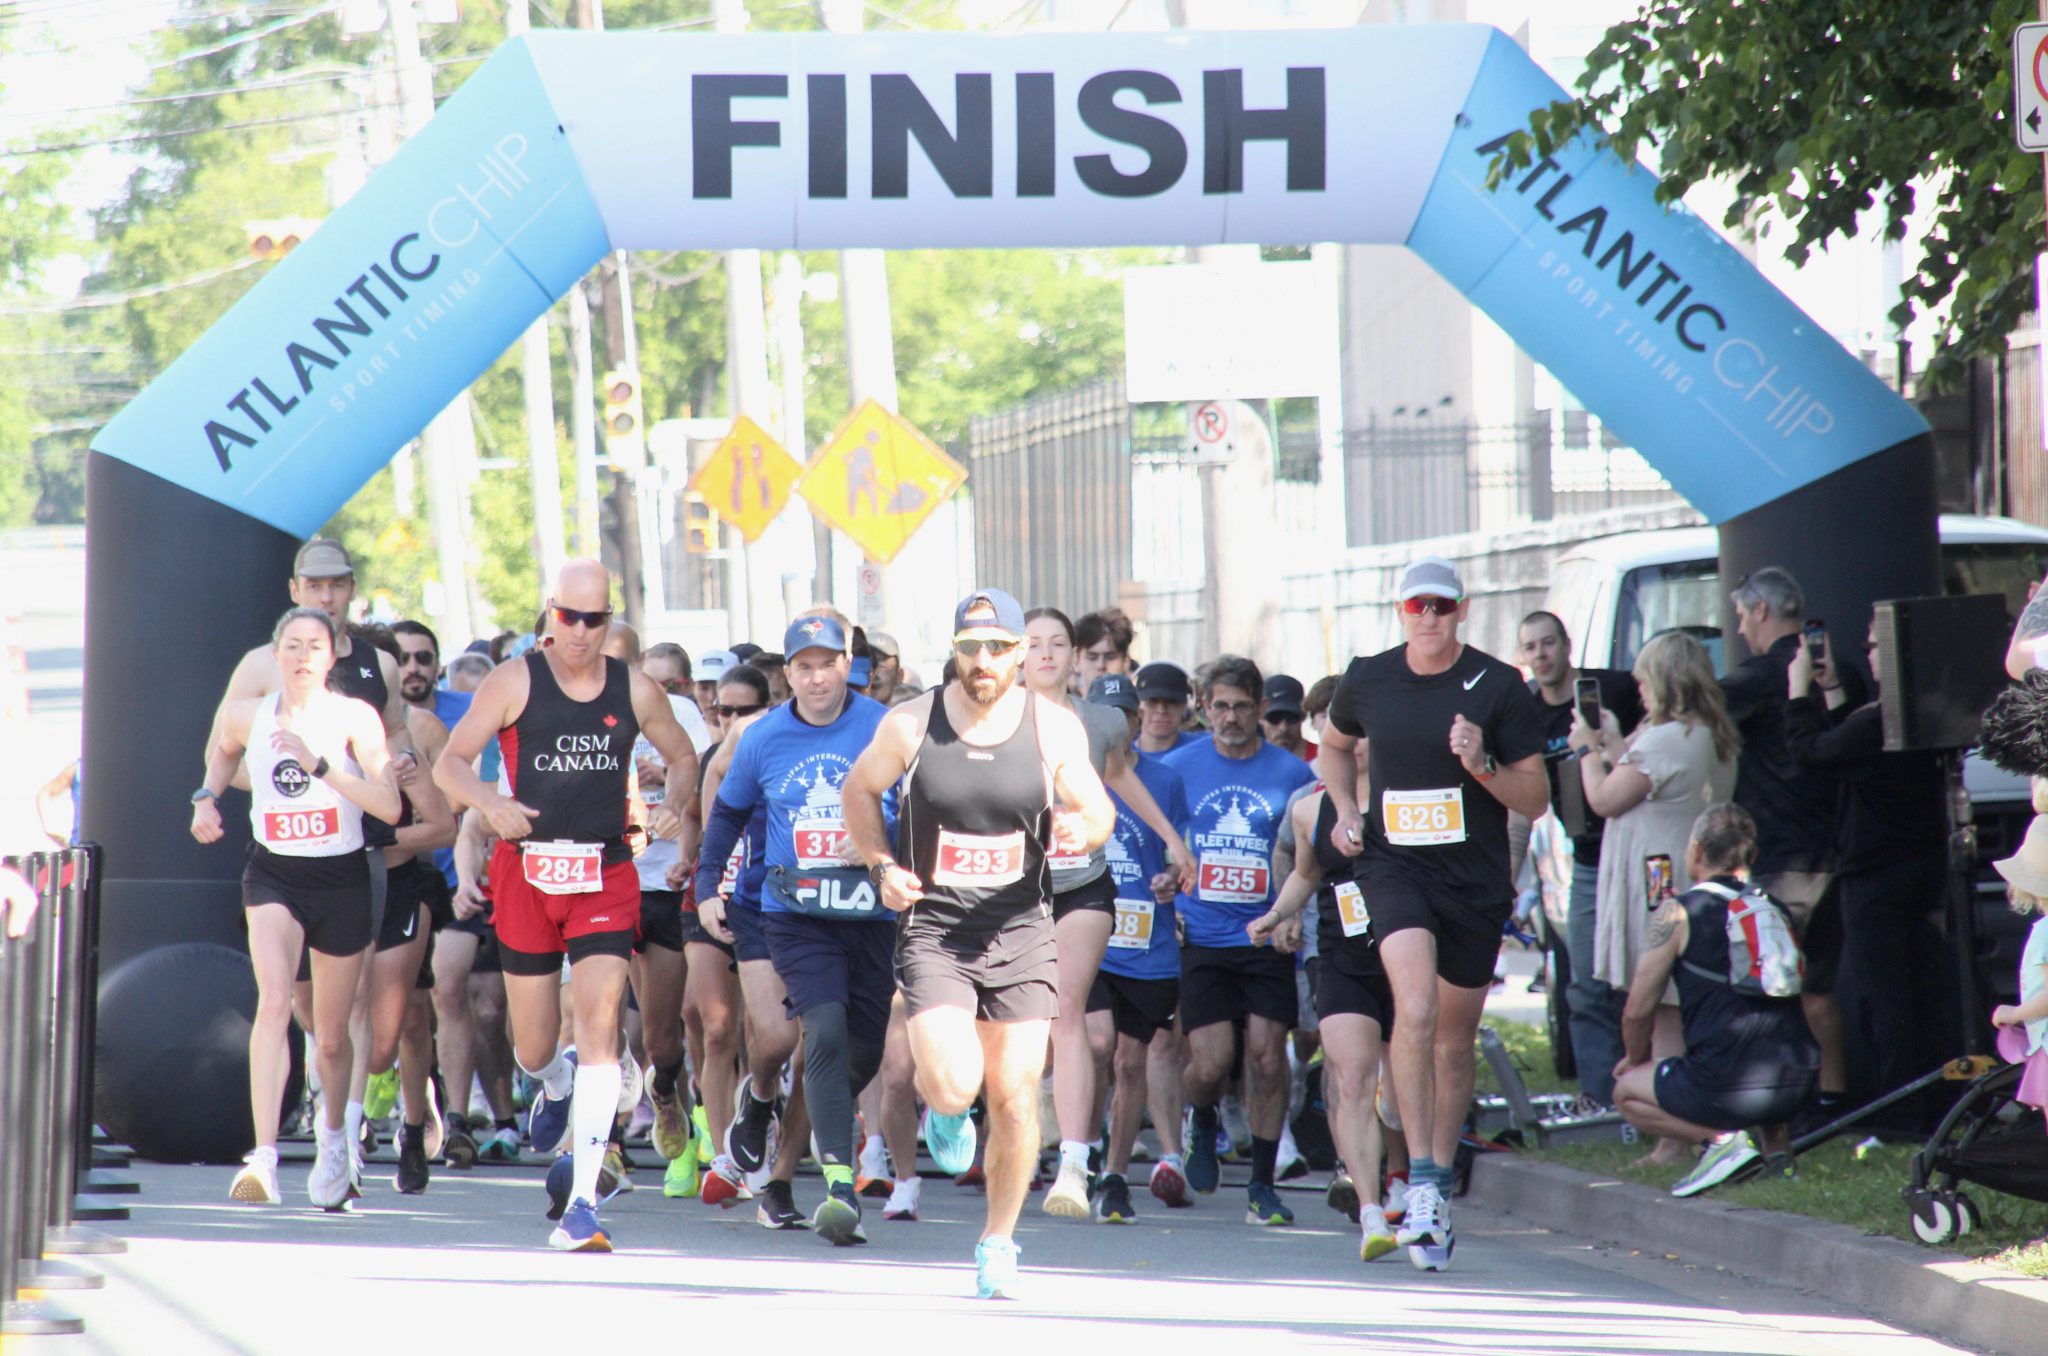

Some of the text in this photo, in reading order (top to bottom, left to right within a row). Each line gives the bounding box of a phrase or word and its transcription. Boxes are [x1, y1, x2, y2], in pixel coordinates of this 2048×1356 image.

[691, 65, 1327, 200] FINISH
[1538, 250, 1695, 396] SPORT TIMING
[329, 265, 482, 413] SPORT TIMING
[556, 734, 611, 753] CISM
[534, 754, 620, 772] CANADA
[780, 760, 806, 795] HALIFAX
[1193, 785, 1274, 822] HALIFAX INTERNATIONAL
[275, 811, 327, 839] 306
[1397, 805, 1449, 831] 826
[1194, 833, 1270, 853] FLEET WEEK
[536, 857, 586, 884] 284
[953, 848, 1009, 874] 293
[1210, 866, 1256, 892] 255
[795, 878, 876, 911] FILA
